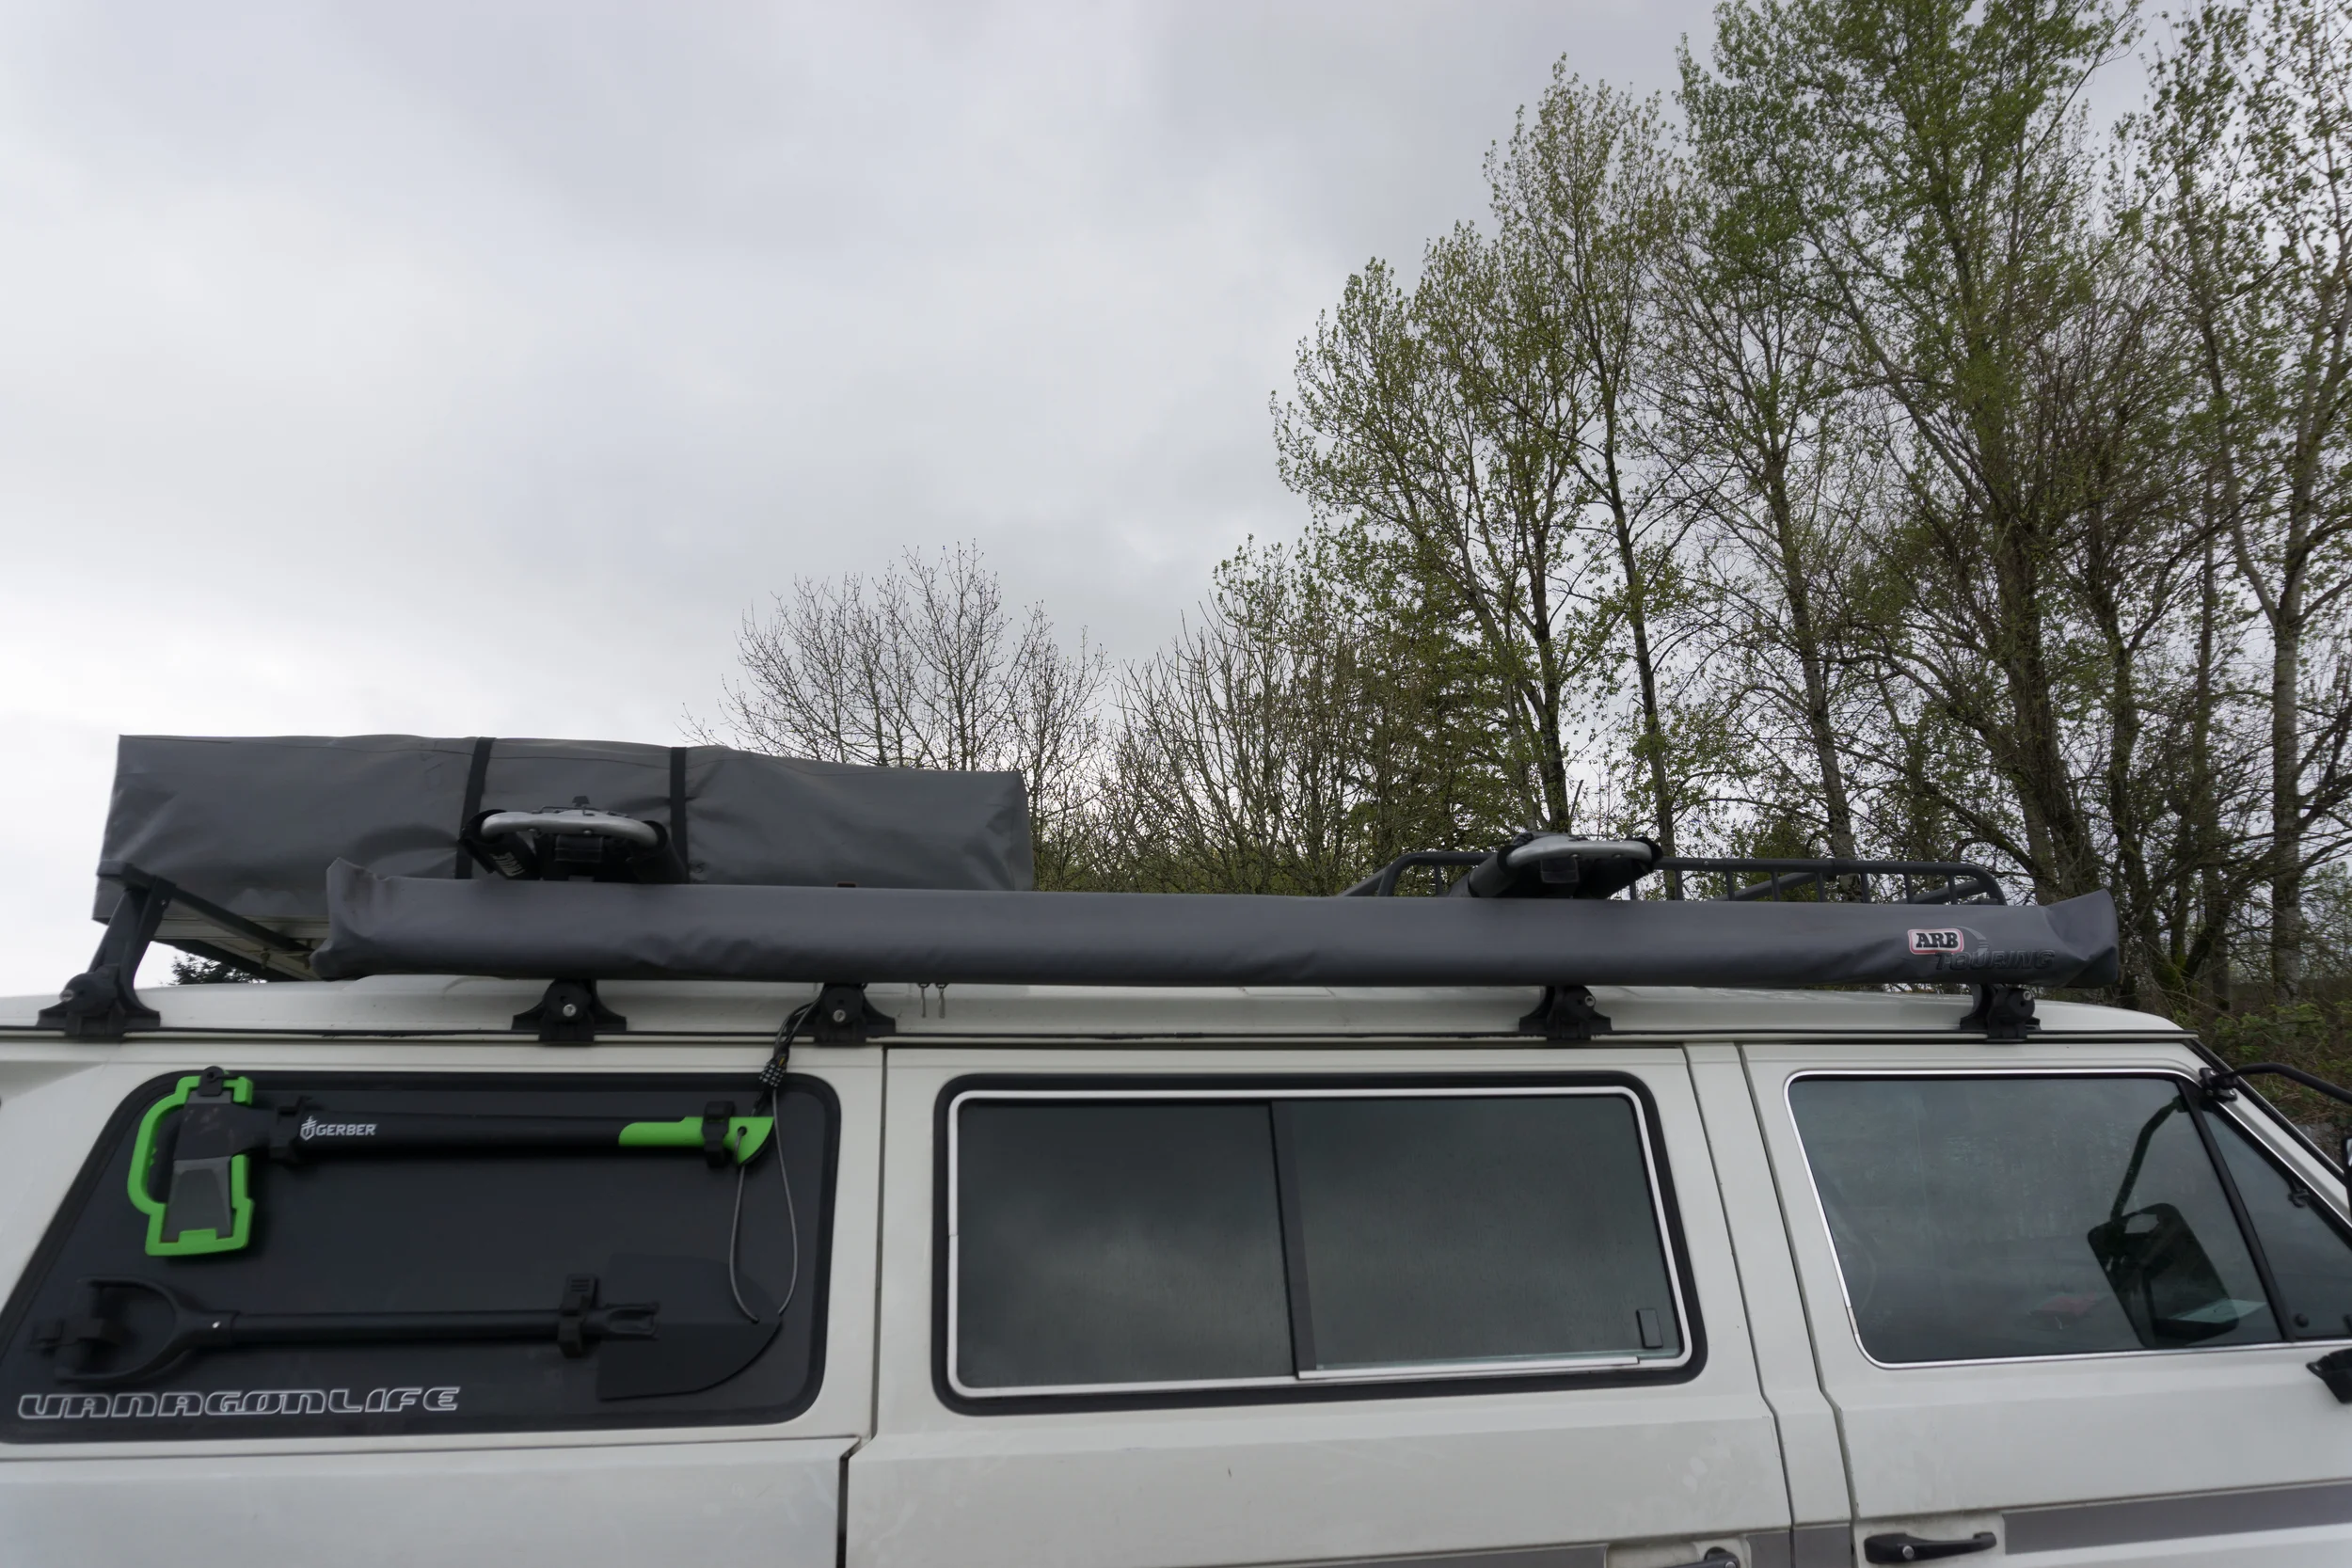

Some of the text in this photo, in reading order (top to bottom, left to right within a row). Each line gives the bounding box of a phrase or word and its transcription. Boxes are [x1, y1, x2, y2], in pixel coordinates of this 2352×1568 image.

[1916, 932, 1958, 948] ARB
[1934, 951, 2055, 970] TOURING
[315, 1124, 377, 1136] GERBER
